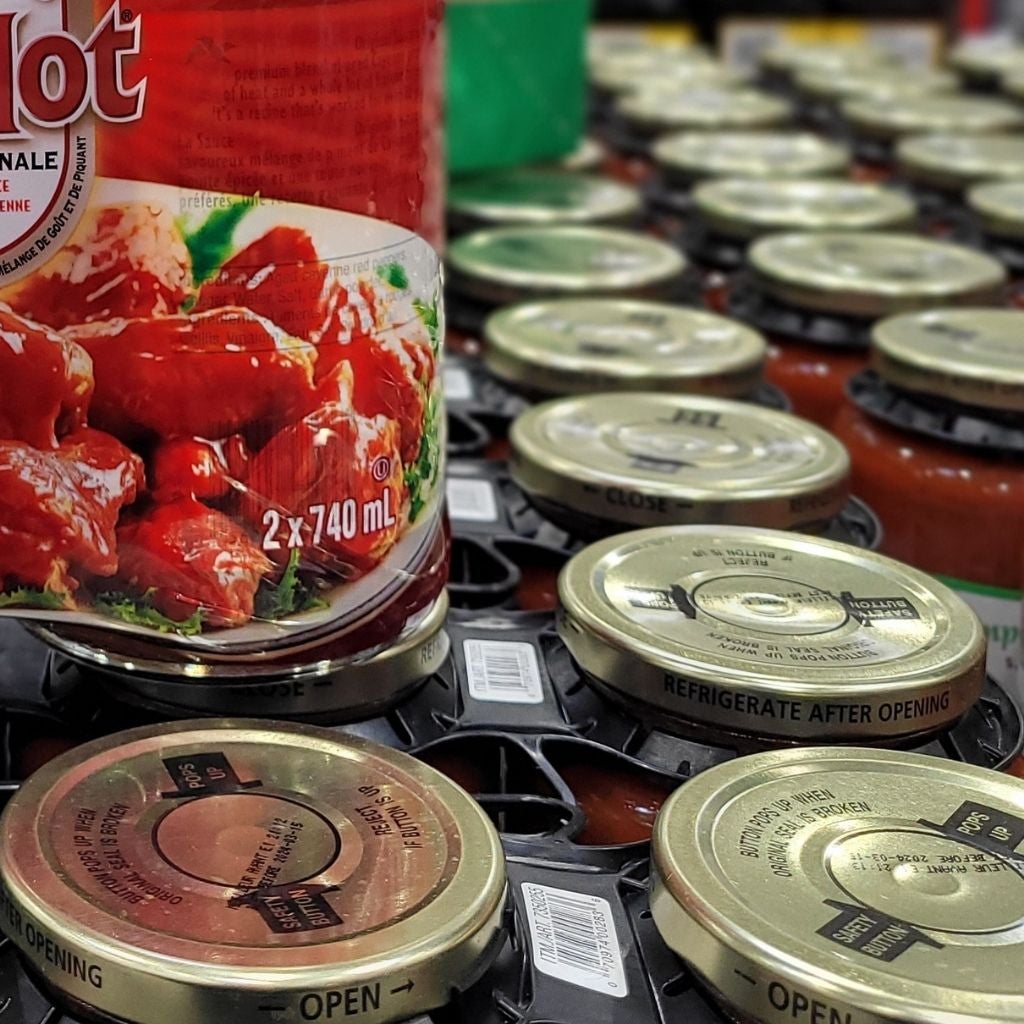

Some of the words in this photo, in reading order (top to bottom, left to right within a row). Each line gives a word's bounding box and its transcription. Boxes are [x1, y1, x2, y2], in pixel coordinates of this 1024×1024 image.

[73, 136, 87, 183] PIQUANT
[69, 183, 82, 199] DE
[64, 199, 74, 214] ET
[35, 236, 51, 251] DE
[262, 509, 281, 550] 2
[287, 516, 304, 548] x
[309, 498, 356, 545] 740
[363, 487, 396, 534] mL
[664, 676, 801, 721] REFRIGERATE
[808, 703, 872, 723] AFTER
[878, 690, 950, 722] OPENING
[178, 763, 206, 789] POPS
[206, 766, 226, 780] UP
[358, 785, 380, 797] UP
[375, 796, 395, 806] IS
[792, 789, 836, 805] WHEN
[749, 807, 780, 828] POPS
[772, 799, 792, 811] UP
[811, 801, 872, 818] BROKEN
[74, 807, 97, 832] WHEN
[100, 802, 131, 835] BROKEN
[355, 806, 393, 835] REJECT
[385, 806, 420, 837] BUTTON
[775, 819, 805, 839] SEAL
[797, 813, 816, 824] IS
[956, 811, 990, 836] POPS
[74, 835, 93, 847] UP
[99, 837, 119, 846] IS
[739, 825, 763, 858] BUTTON
[988, 826, 1013, 841] UP
[77, 850, 104, 872] POPS
[103, 849, 130, 870] SEAL
[768, 840, 793, 877] ORIGINAL
[93, 872, 144, 904] BUTTON
[123, 871, 183, 905] ORIGINAL
[263, 896, 301, 929] SAFETY
[288, 889, 330, 926] BUTTON
[832, 914, 877, 943] SAFETY
[861, 924, 909, 957] BUTTON
[26, 923, 102, 988] OPENING
[299, 982, 381, 1021] OPEN
[767, 981, 854, 1024] OPEN
